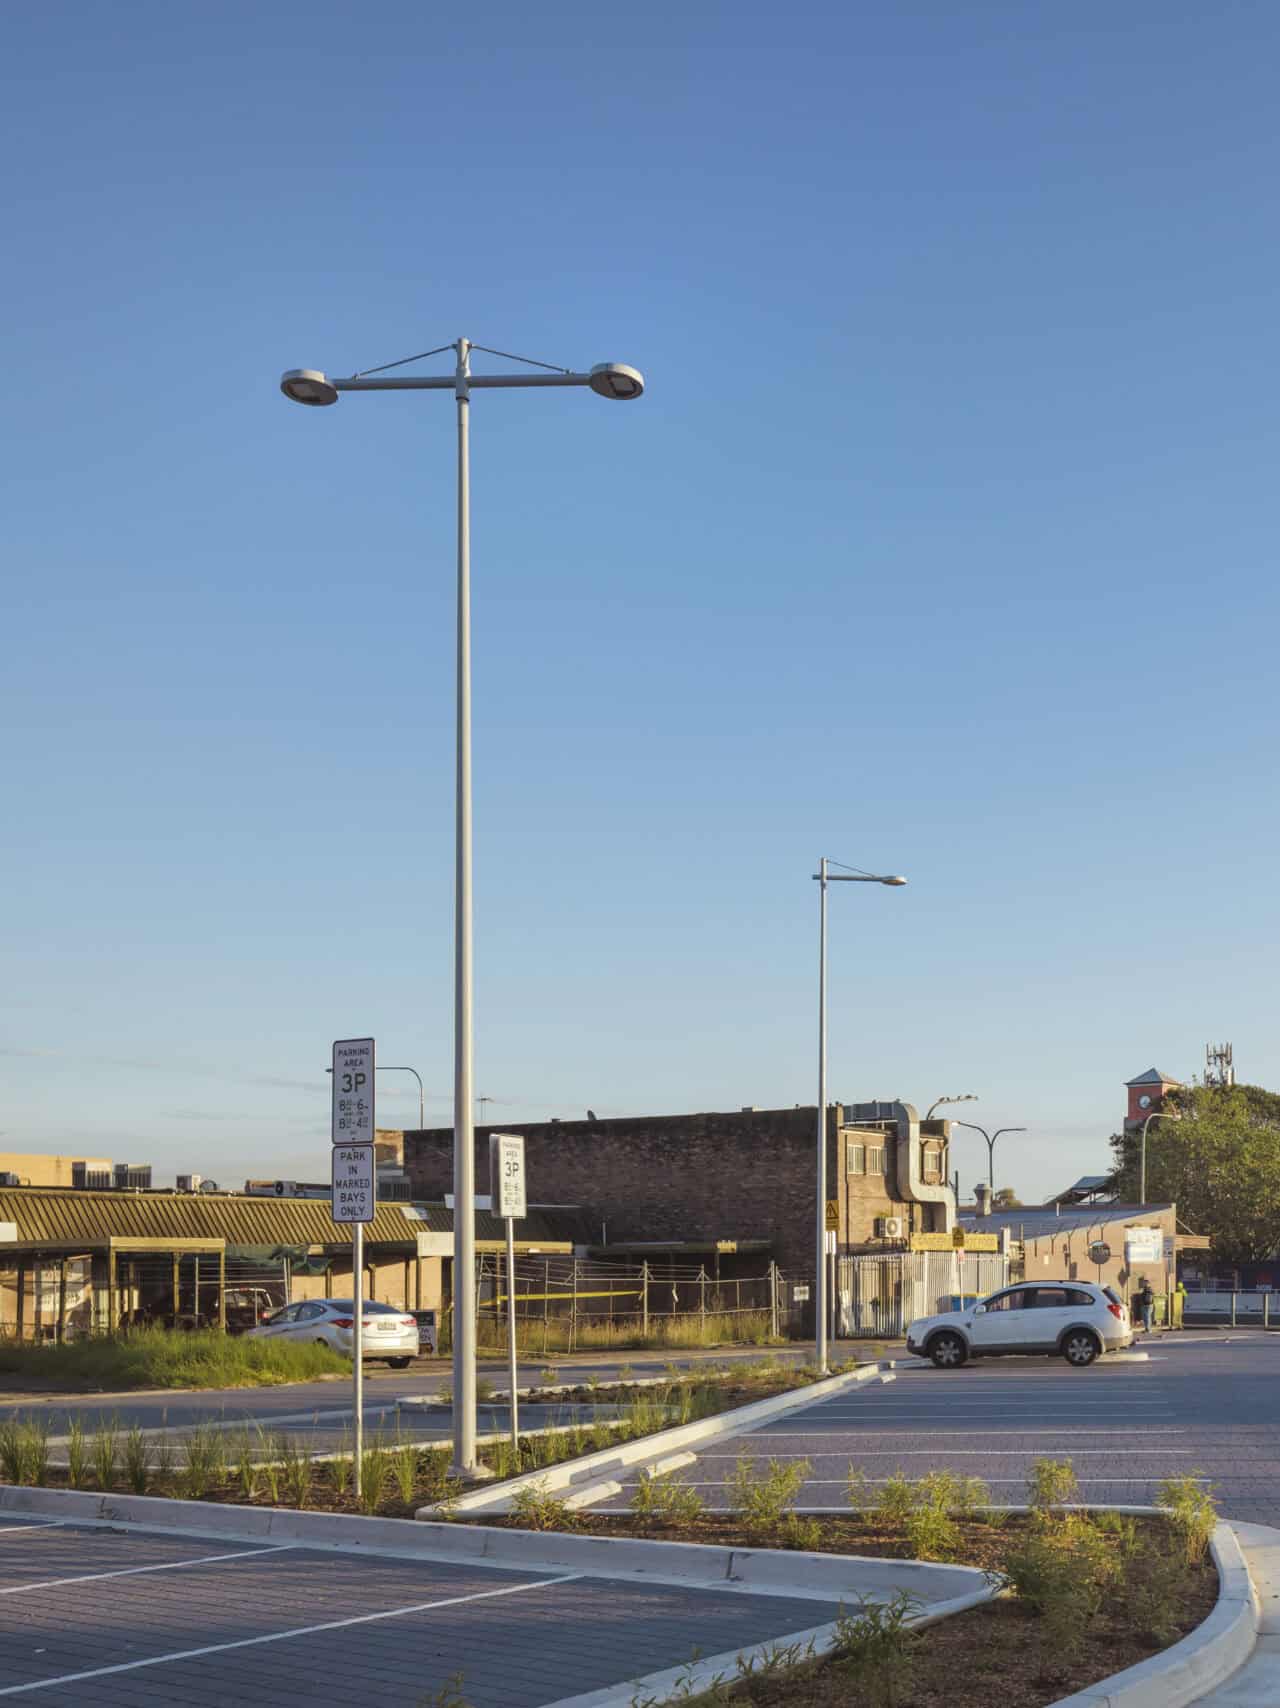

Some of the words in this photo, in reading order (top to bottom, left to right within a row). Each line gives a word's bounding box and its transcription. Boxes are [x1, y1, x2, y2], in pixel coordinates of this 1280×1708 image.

[338, 1047, 369, 1056] PARKING
[344, 1058, 363, 1067] AREA
[342, 1072, 366, 1094] 3P
[340, 1151, 366, 1161] PARK
[348, 1165, 358, 1176] IN
[505, 1161, 519, 1177] 3P
[335, 1178, 370, 1189] MARKED
[340, 1192, 366, 1203] BAYS
[340, 1206, 366, 1217] ONLY
